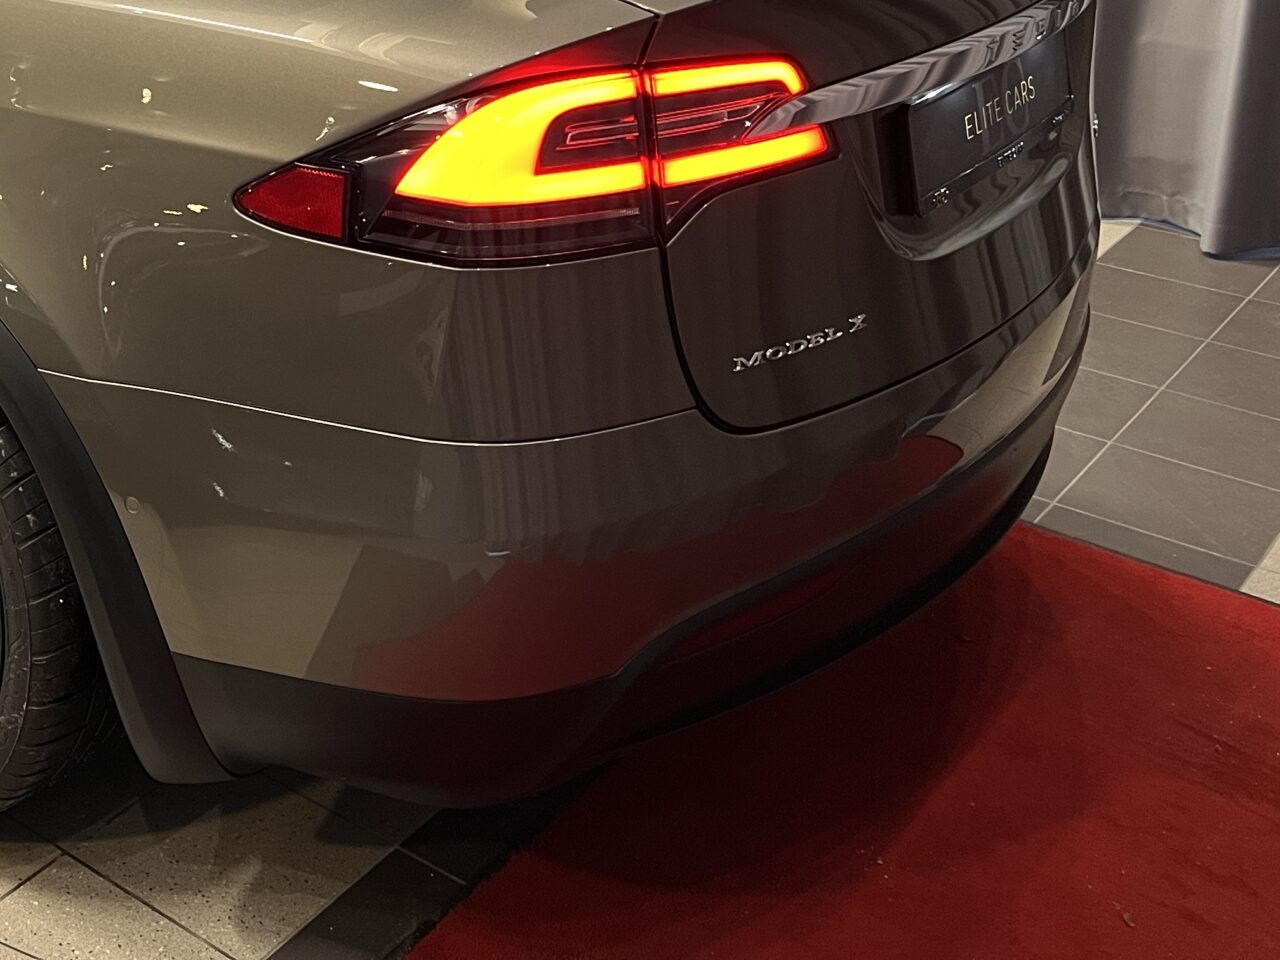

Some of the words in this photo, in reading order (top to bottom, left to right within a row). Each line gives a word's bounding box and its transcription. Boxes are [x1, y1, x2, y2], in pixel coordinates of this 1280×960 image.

[964, 96, 1002, 140] ELITE
[1005, 76, 1036, 115] CARS
[732, 327, 844, 372] MODEL
[848, 313, 868, 333] X
